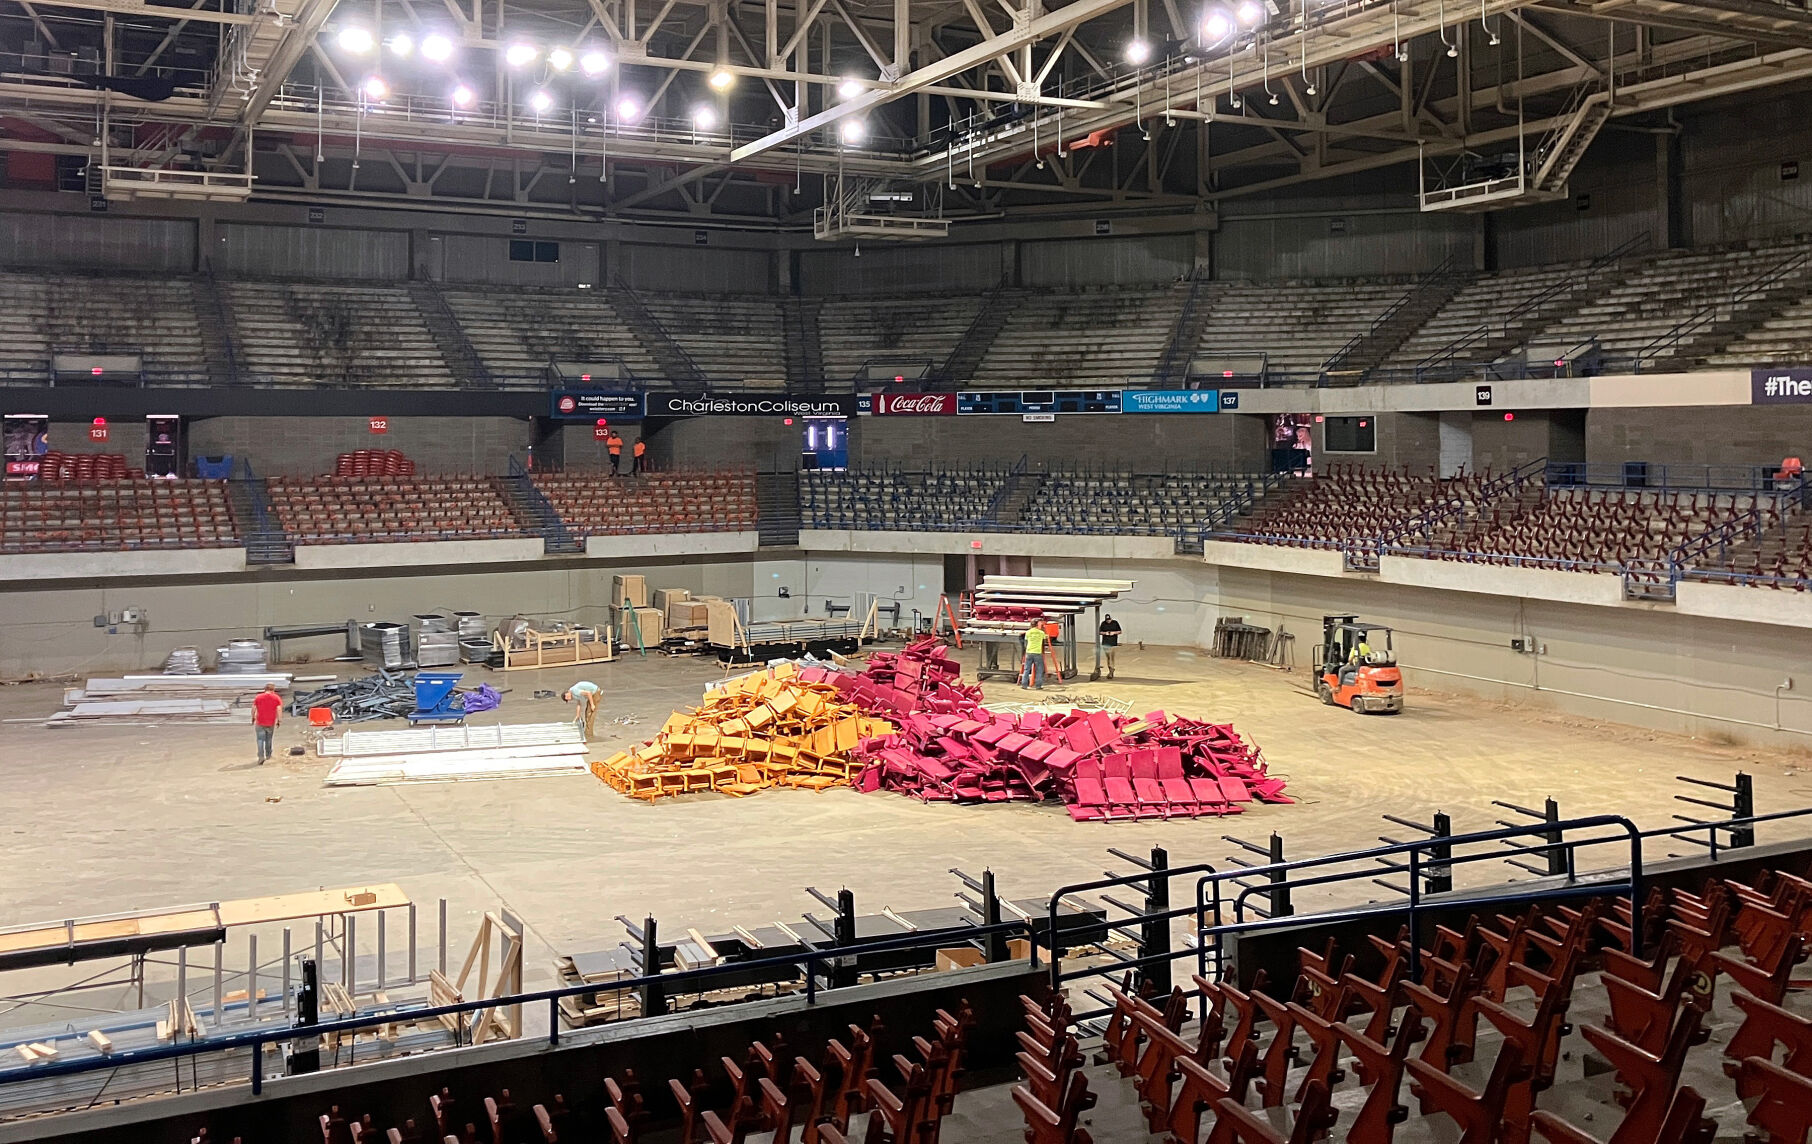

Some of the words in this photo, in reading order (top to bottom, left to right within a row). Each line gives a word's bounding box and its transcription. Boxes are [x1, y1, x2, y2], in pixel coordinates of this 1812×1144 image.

[1764, 376, 1812, 397] #The
[1137, 395, 1188, 404] HIGHMARK
[1477, 391, 1490, 400] 139
[858, 400, 871, 408] 135
[890, 395, 947, 413] Coca-Cola
[1222, 396, 1236, 405] 137
[370, 421, 386, 429] 132
[90, 429, 107, 438] 131
